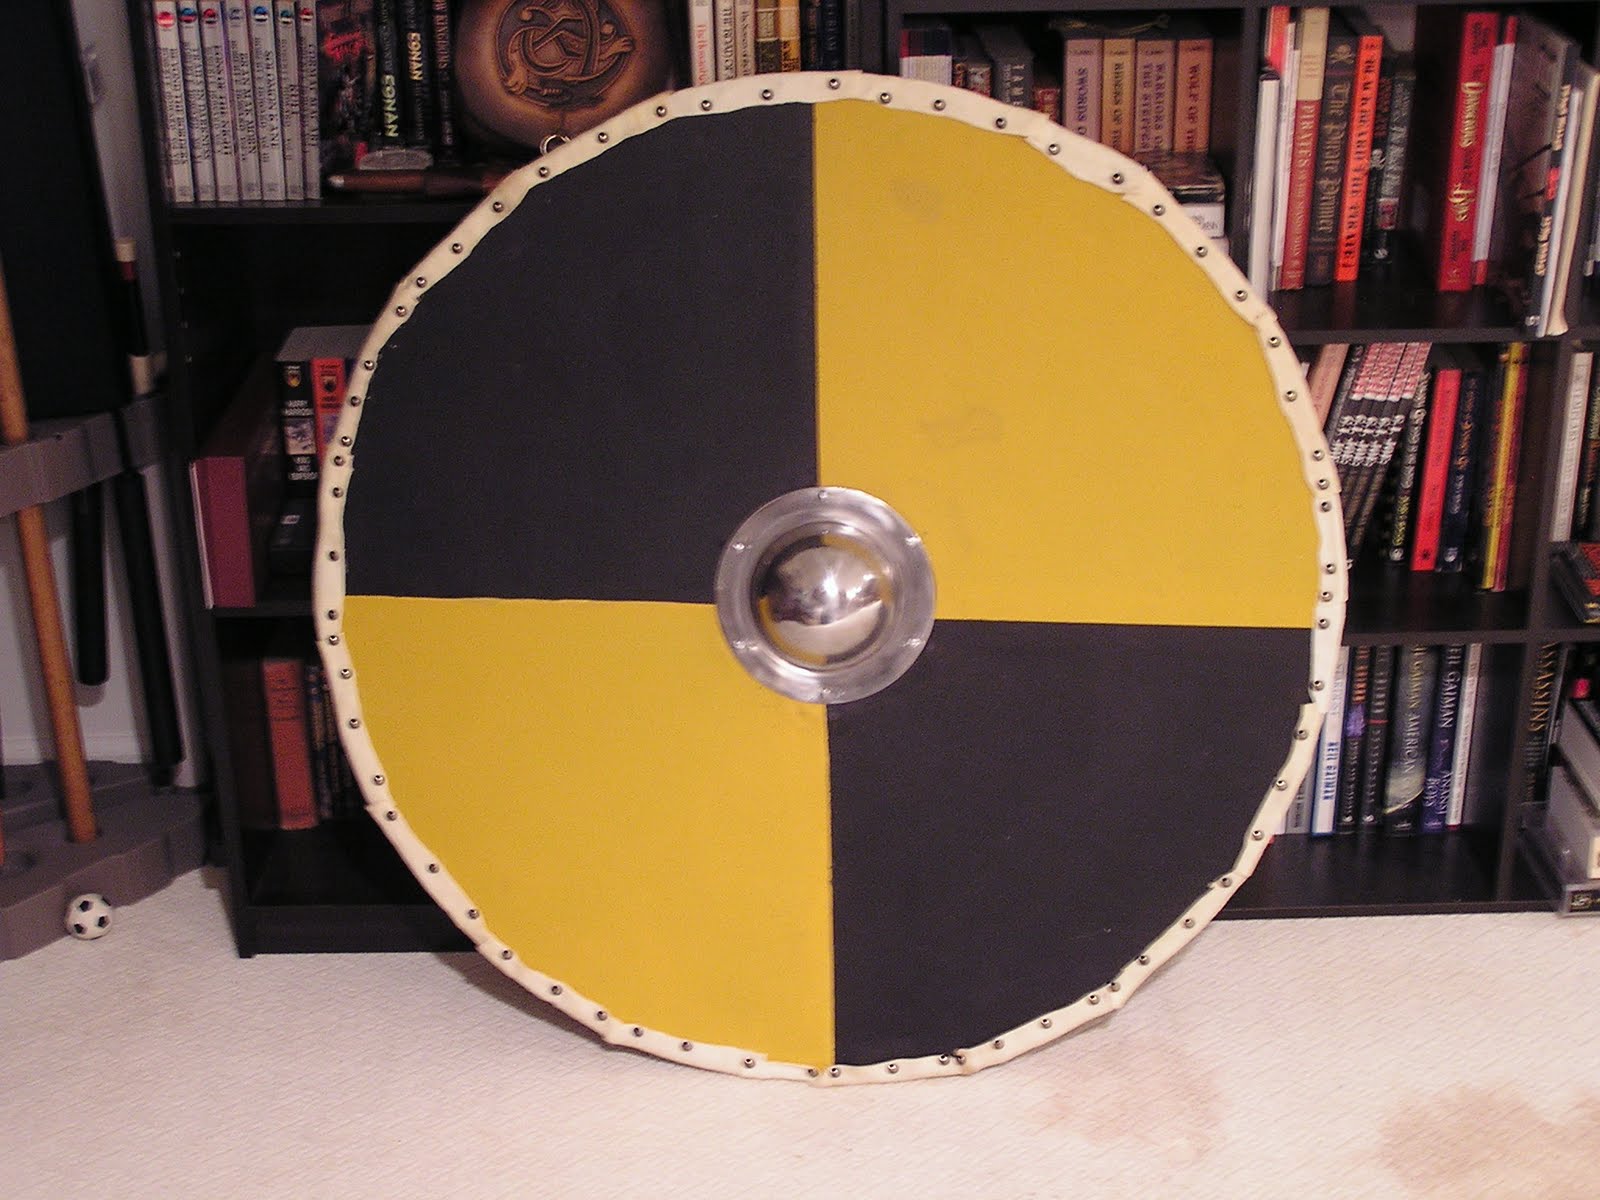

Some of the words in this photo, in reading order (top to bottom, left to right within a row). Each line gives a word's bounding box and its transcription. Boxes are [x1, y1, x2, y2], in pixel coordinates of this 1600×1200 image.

[407, 32, 424, 81] CONAN
[435, 15, 449, 70] KINGDOMS
[1076, 67, 1089, 121] SWORDS
[1113, 62, 1124, 106] RIDERS
[1142, 63, 1153, 88] THE
[1154, 63, 1166, 130] WARRIORS
[1188, 63, 1200, 102] WOLF
[381, 74, 399, 138] CONAN
[1112, 109, 1123, 124] OF
[1187, 106, 1199, 123] OF
[1329, 82, 1350, 117] The
[1299, 104, 1315, 168] PIRATES
[1322, 121, 1347, 173] Pirate
[1317, 176, 1342, 234] Primer
[1350, 166, 1367, 197] THE
[1407, 660, 1425, 709] GAIMAN
[1438, 671, 1461, 728] GAIMAN
[1327, 741, 1339, 761] NEIL
[1402, 712, 1421, 773] AMERICAN
[1323, 764, 1337, 801] GAIMAN
[1422, 777, 1441, 807] BOYS
[1436, 770, 1453, 815] ANANSI
